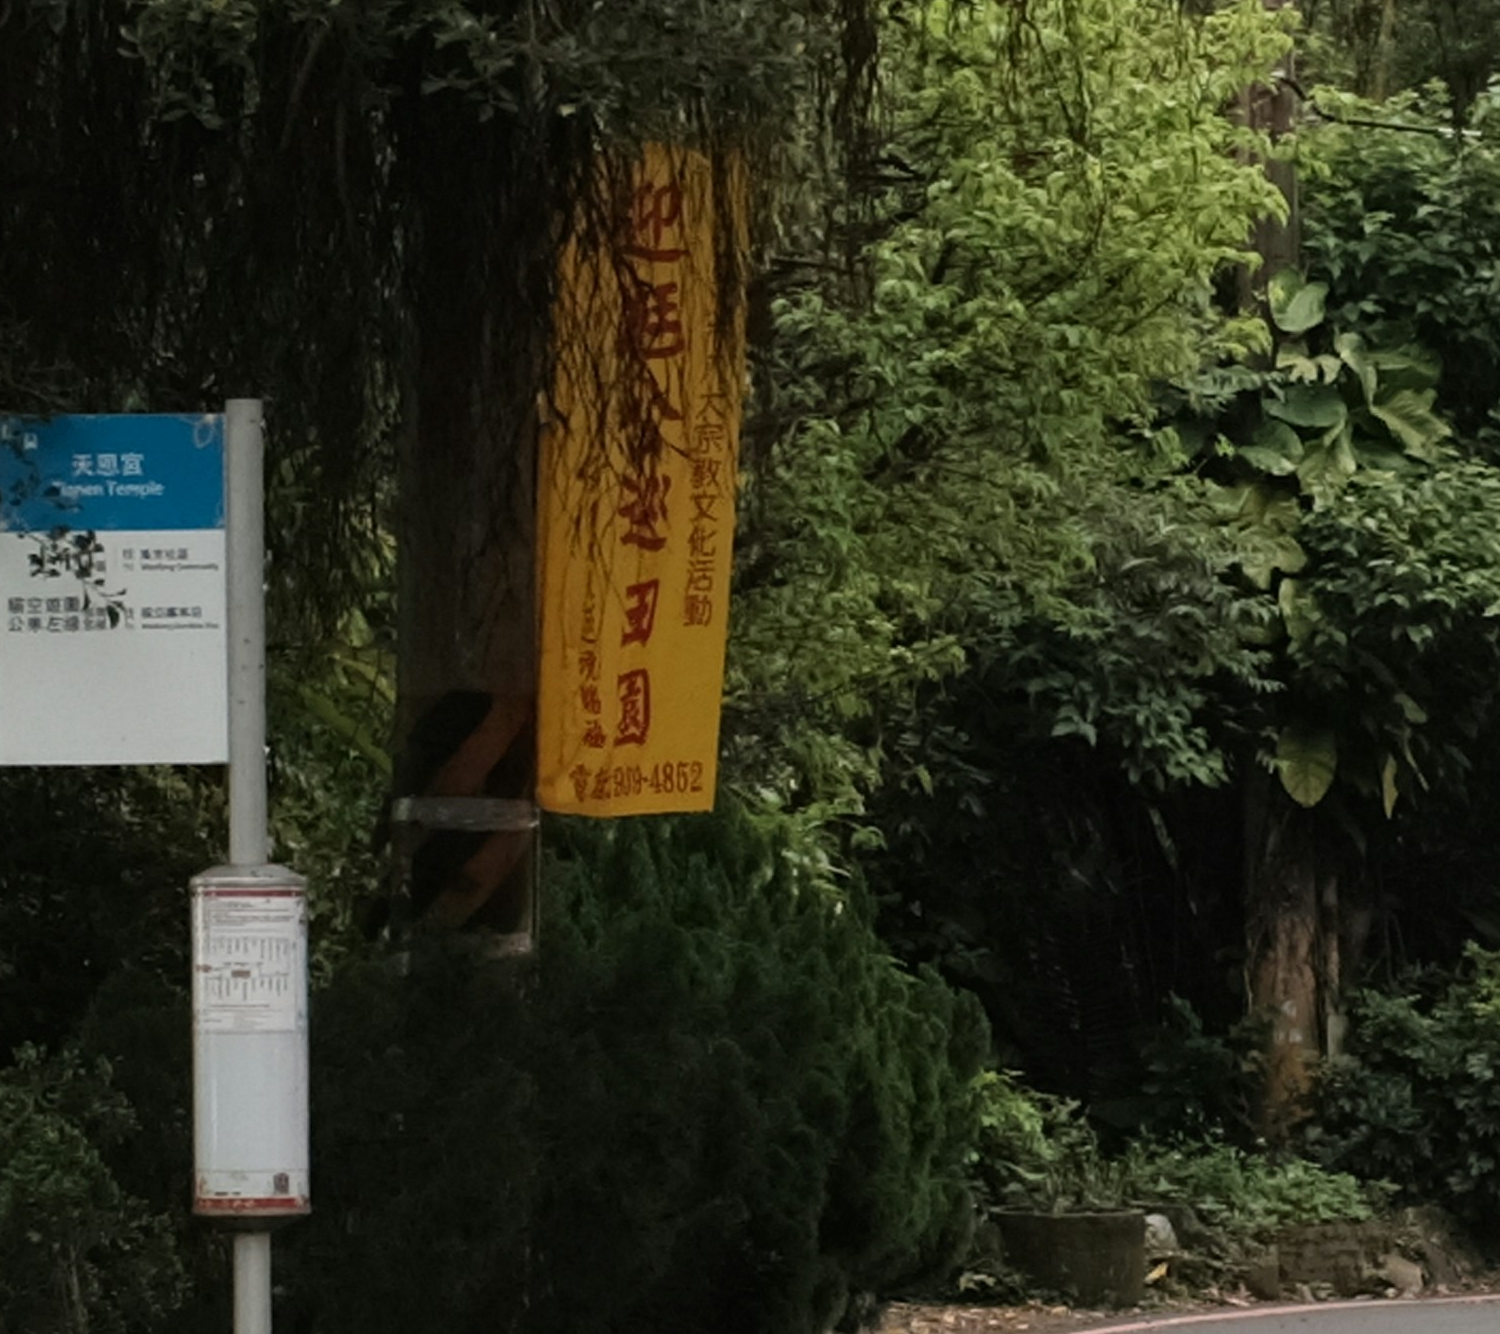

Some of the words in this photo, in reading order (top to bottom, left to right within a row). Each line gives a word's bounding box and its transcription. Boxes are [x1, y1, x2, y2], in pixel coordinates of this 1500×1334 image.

[72, 452, 145, 477] 天恩宮
[106, 480, 165, 499] Temple
[683, 349, 729, 628] 大宗教文化活動
